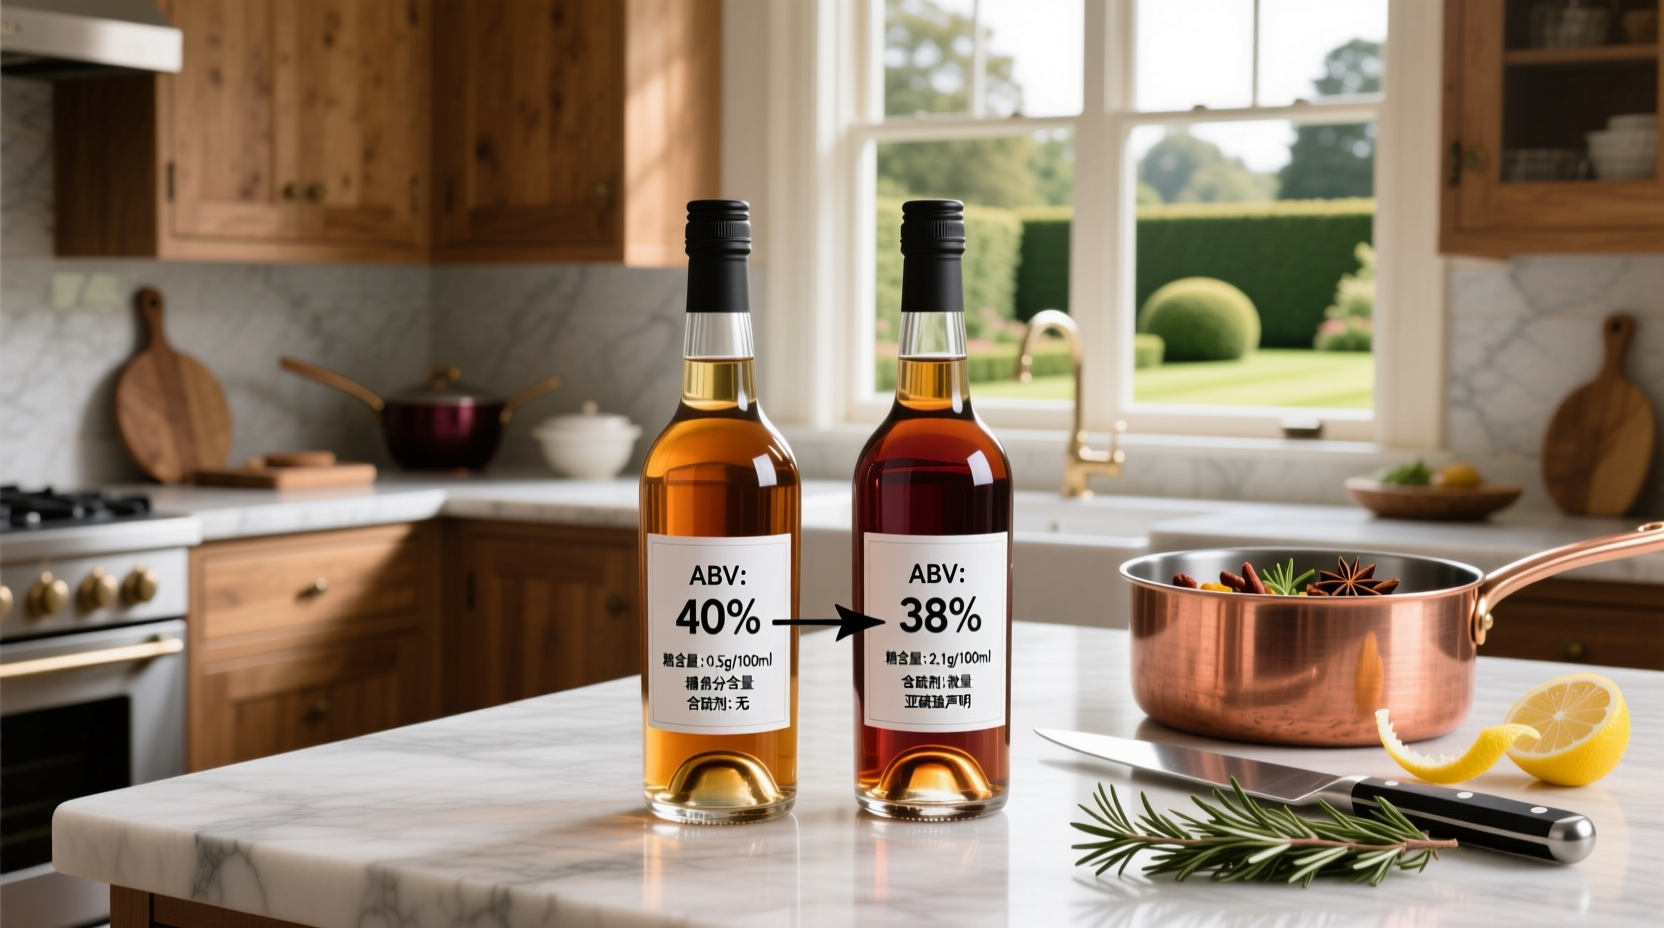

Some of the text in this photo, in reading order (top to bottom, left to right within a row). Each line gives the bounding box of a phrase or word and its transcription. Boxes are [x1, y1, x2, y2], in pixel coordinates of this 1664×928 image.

[689, 565, 746, 586] ABV:
[908, 563, 965, 584] ABV:
[675, 598, 761, 635] 40%
[899, 596, 982, 633] 38%
